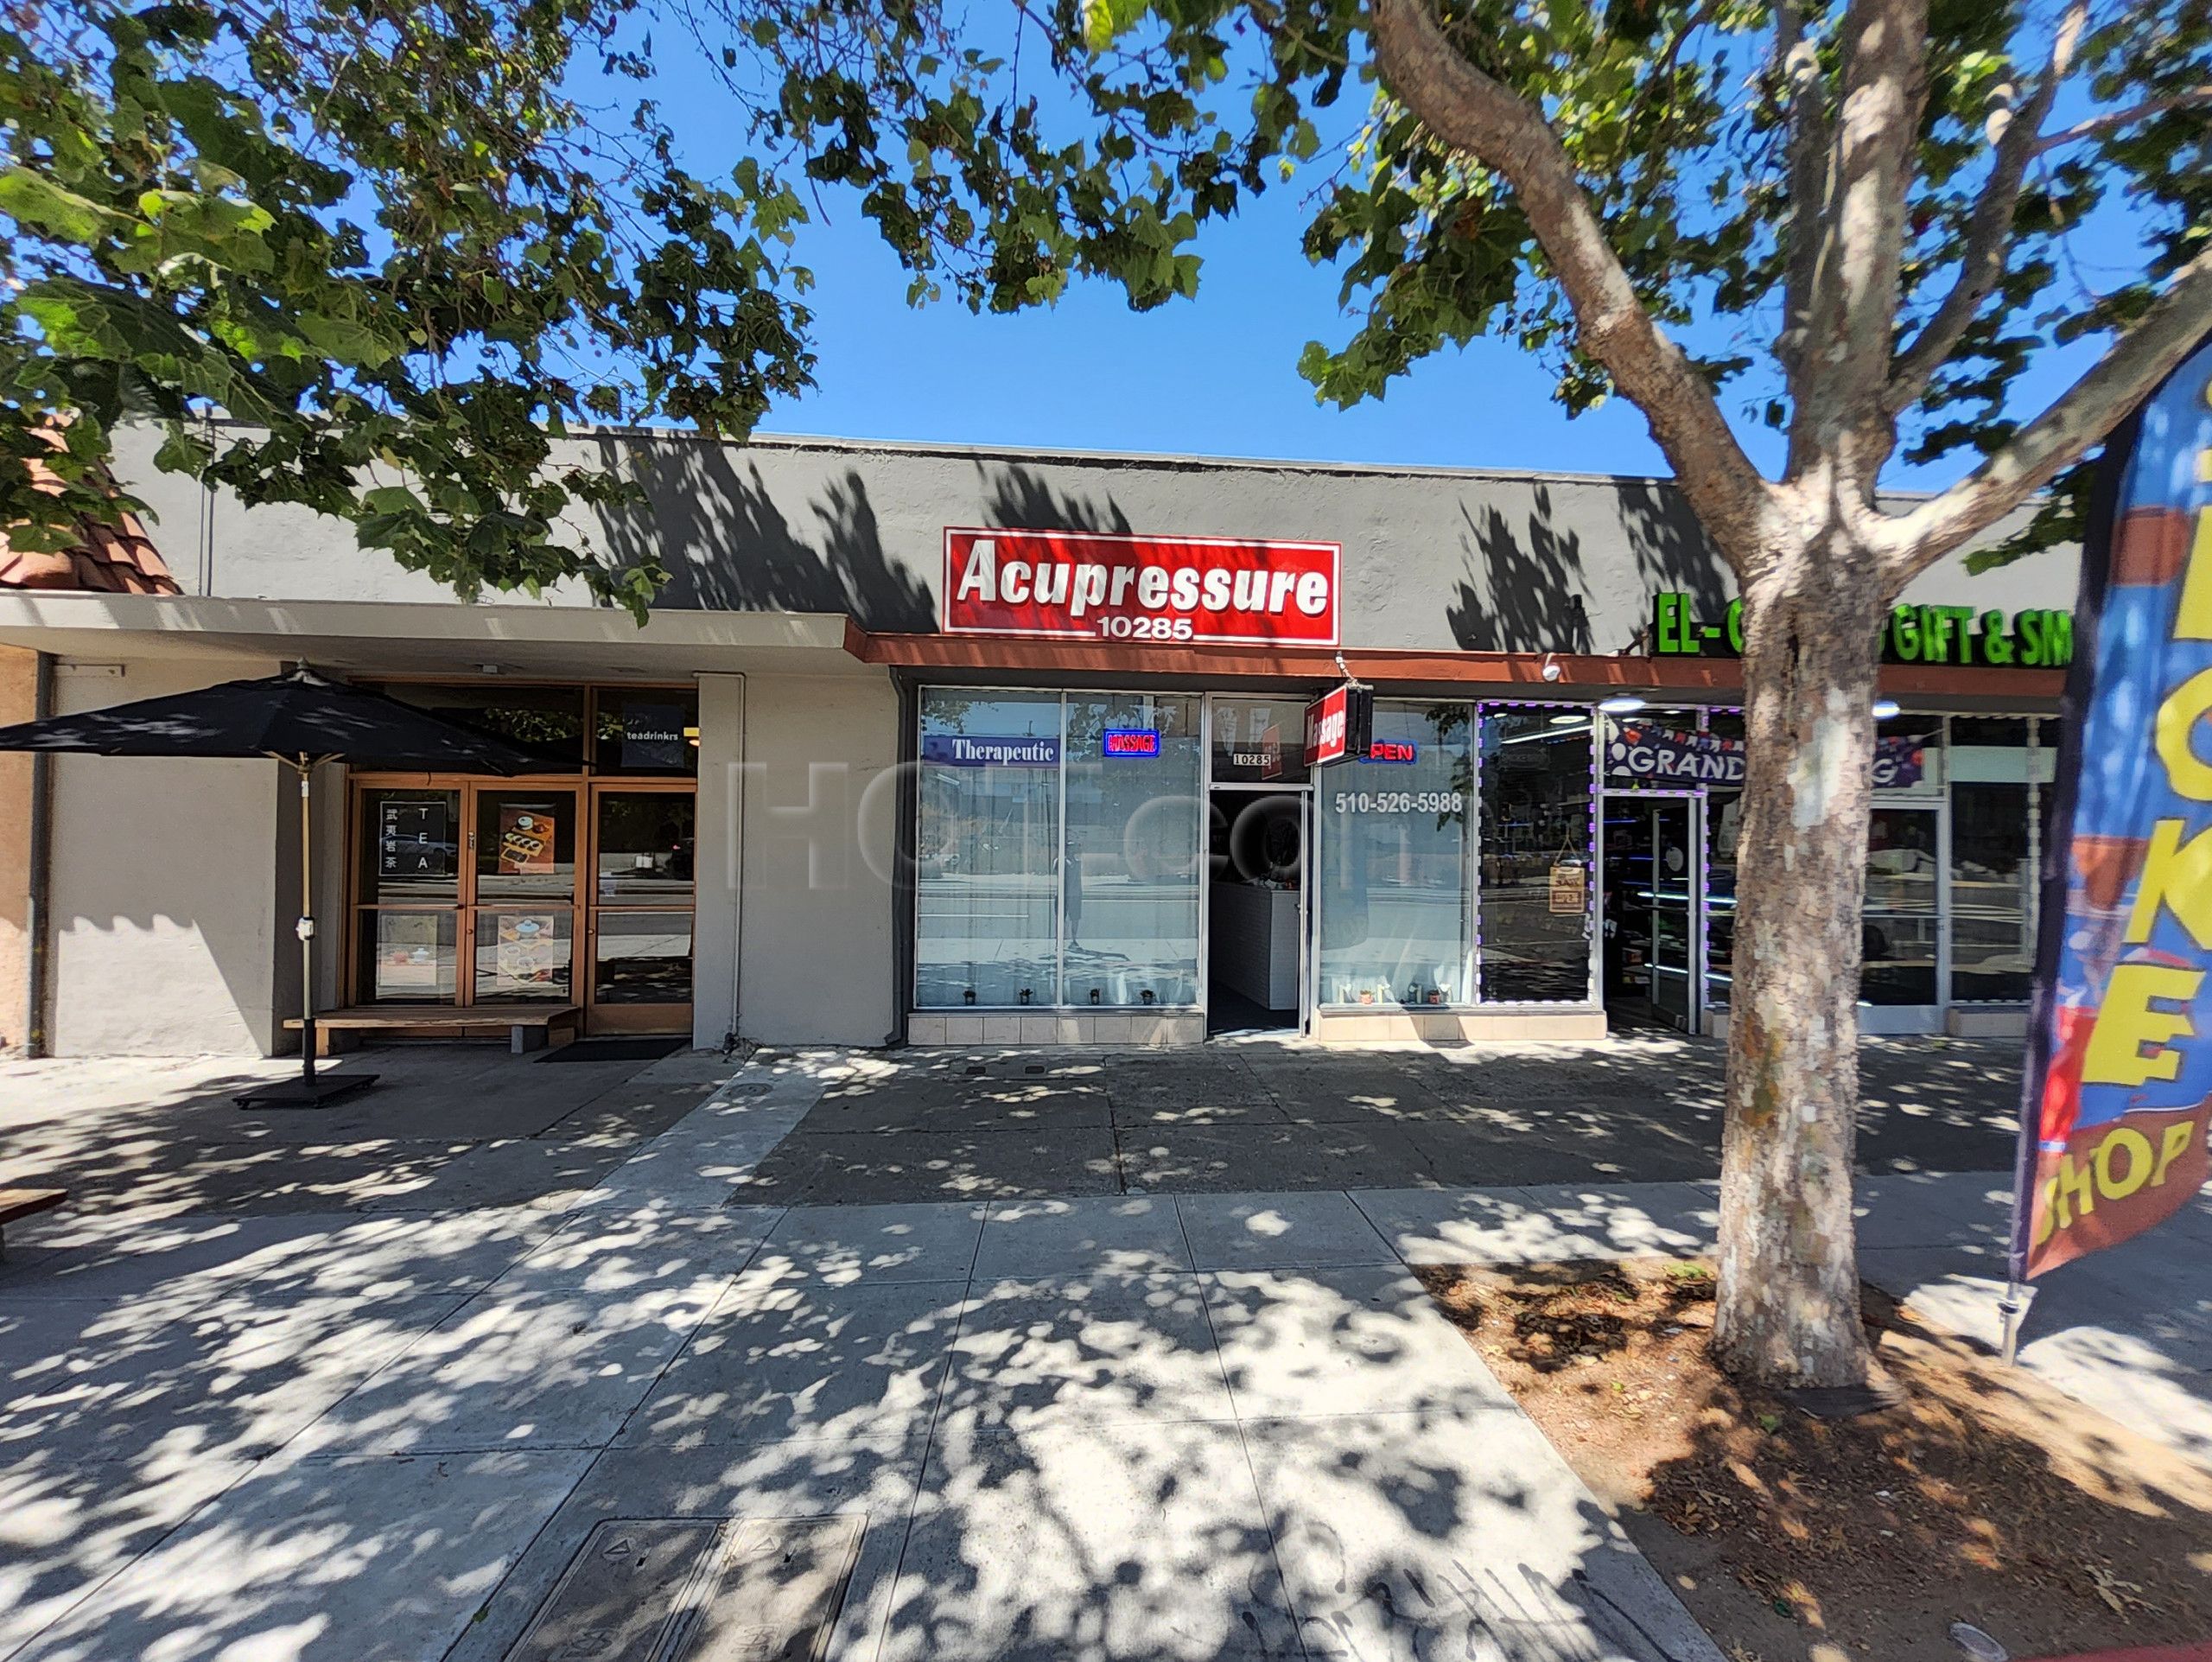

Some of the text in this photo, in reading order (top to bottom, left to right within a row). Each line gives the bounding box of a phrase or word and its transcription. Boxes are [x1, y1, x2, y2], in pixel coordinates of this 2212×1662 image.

[957, 539, 1328, 616] Acupressure
[1097, 616, 1193, 640] 10285
[1892, 603, 1974, 664] GIFT
[1984, 608, 2015, 664] &
[2021, 608, 2073, 665] SM
[626, 730, 678, 741] teadrinkrs
[1306, 710, 1344, 750] Massage
[951, 738, 1054, 766] Therapeutic
[1235, 755, 1270, 765] 10285
[1370, 743, 1413, 761] PEN
[1628, 746, 1745, 780] GRAND
[1335, 792, 1463, 813] 510-526-5988
[417, 807, 429, 869] TEA
